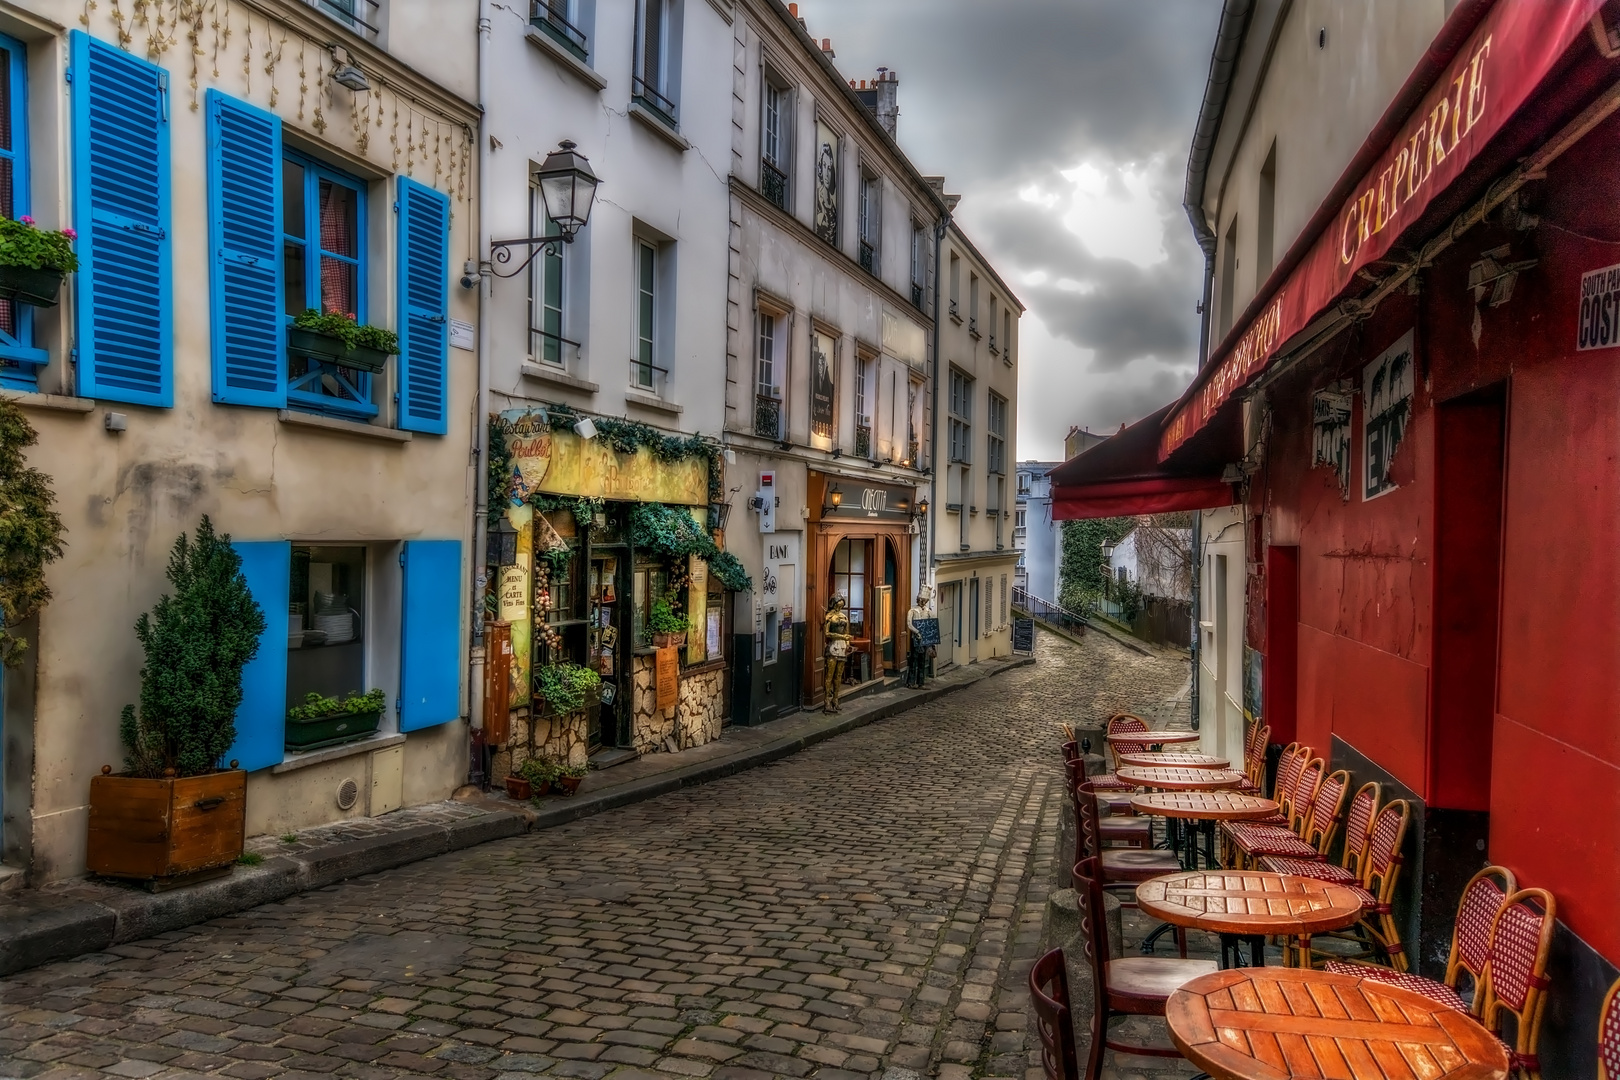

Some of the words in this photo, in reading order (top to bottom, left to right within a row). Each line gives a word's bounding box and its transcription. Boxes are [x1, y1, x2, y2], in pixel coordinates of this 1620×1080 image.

[1341, 33, 1493, 265] CREPERIE
[1582, 271, 1607, 298] SOUTH
[1579, 290, 1620, 349] COST
[498, 416, 550, 435] Restaurant
[509, 439, 551, 459] Poulbot
[770, 544, 789, 559] BANK
[505, 591, 522, 599] CARTE
